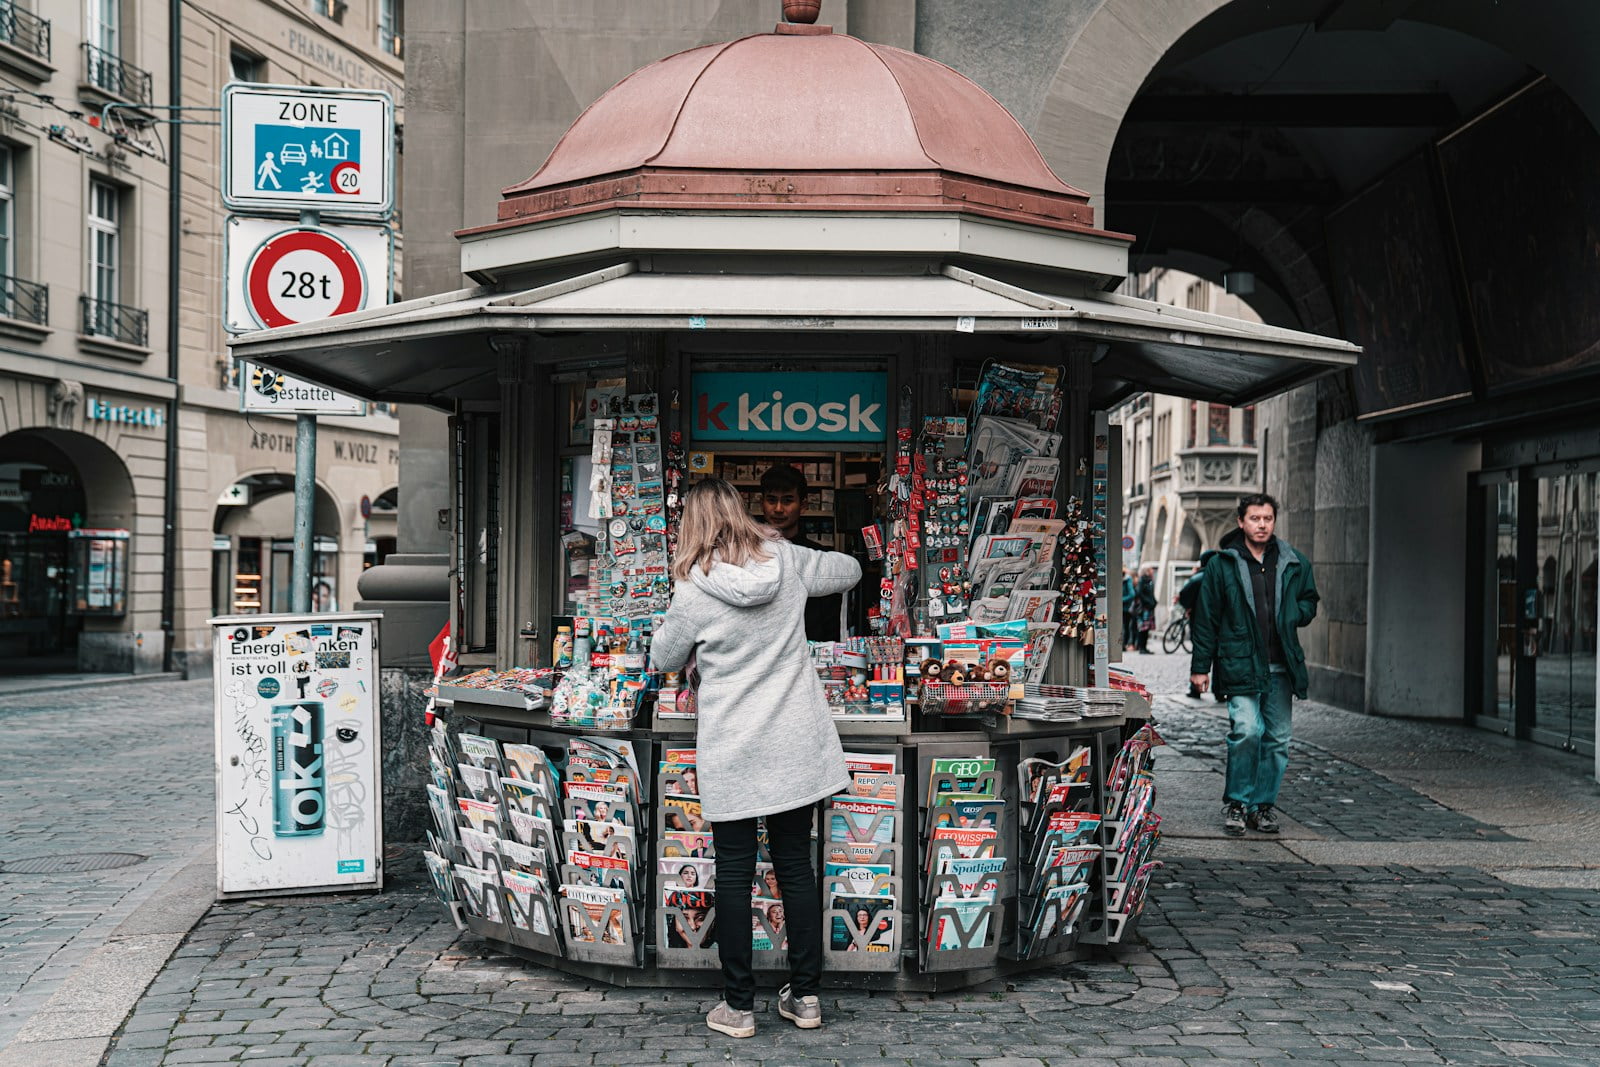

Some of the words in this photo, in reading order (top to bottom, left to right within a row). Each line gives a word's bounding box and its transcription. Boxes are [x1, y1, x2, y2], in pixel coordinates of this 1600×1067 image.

[289, 28, 365, 86] PHARMACIE
[279, 102, 338, 123] ZONE
[342, 173, 358, 187] 20
[697, 392, 729, 430] k
[738, 390, 882, 432] kiosk
[251, 433, 297, 454] APOTH
[997, 541, 1022, 552] TIME
[231, 640, 285, 656] Energi
[319, 639, 359, 651] nken
[231, 663, 252, 675] ist
[257, 661, 286, 674] voll
[948, 762, 981, 776] GEO
[952, 861, 1001, 875] Spotlight
[664, 891, 714, 908] VOGU
[1051, 887, 1087, 899] PLAYOY
